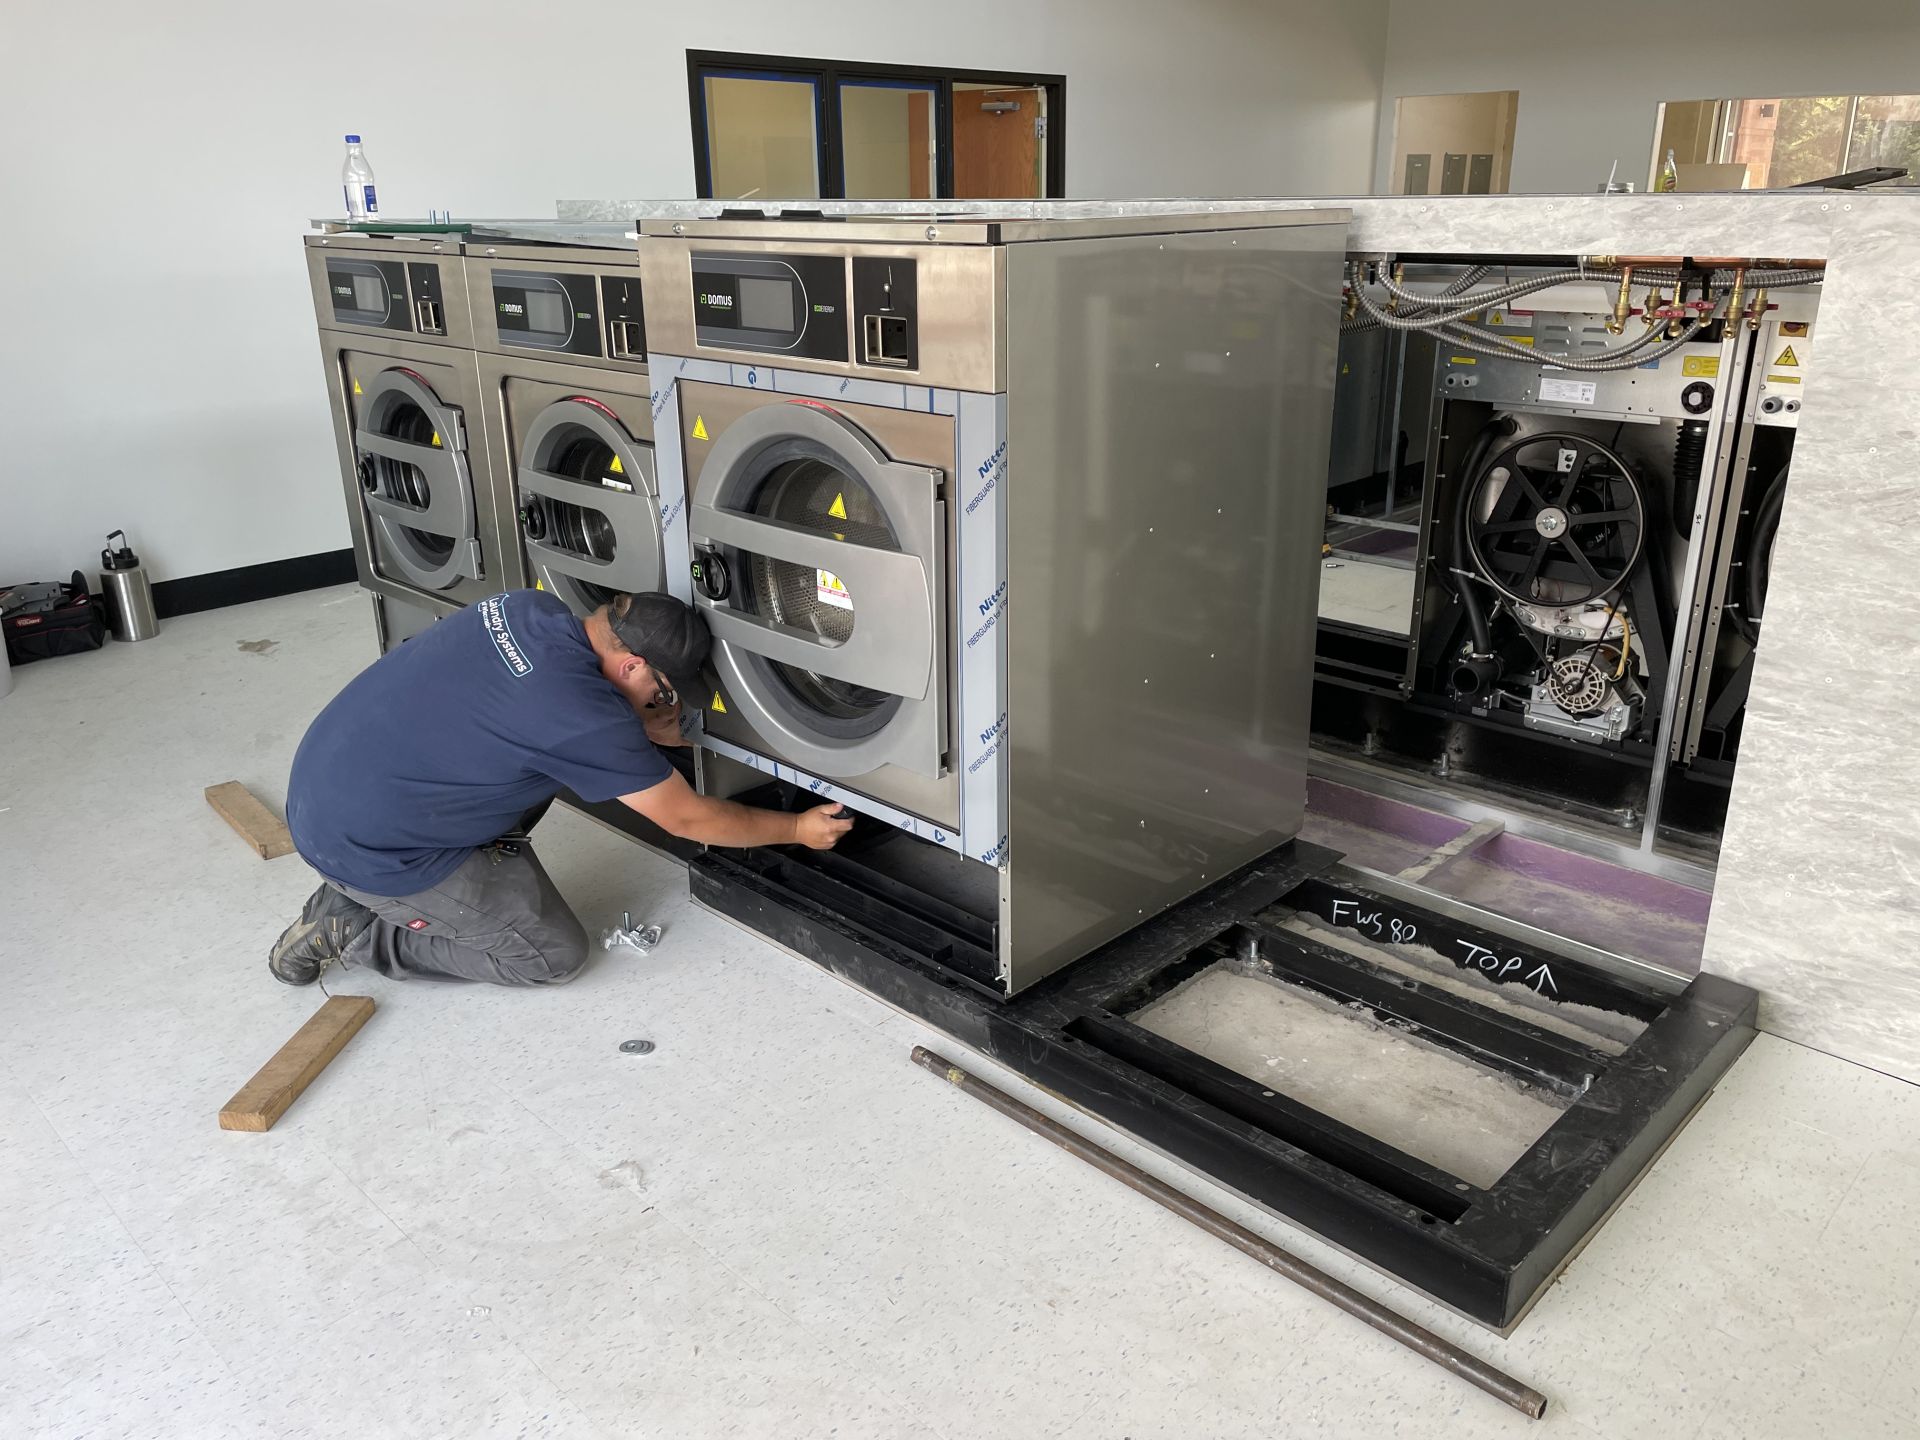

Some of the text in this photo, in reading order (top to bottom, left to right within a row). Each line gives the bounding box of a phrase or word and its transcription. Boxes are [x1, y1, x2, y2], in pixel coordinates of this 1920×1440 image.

[504, 303, 523, 313] DOMUS
[708, 294, 733, 306] DOMUS
[978, 440, 1006, 479] Nitto
[965, 479, 995, 516] FIBERGUARD
[979, 580, 1006, 616] Nitto
[489, 598, 528, 673] Laundry Systems
[966, 616, 996, 649] FIBERGUARD
[979, 711, 1007, 745] Nitto
[968, 745, 996, 775] FIBERGUARD
[981, 834, 1007, 864] Nitto
[1390, 918, 1417, 944] 80
[1456, 938, 1522, 977] TOP
